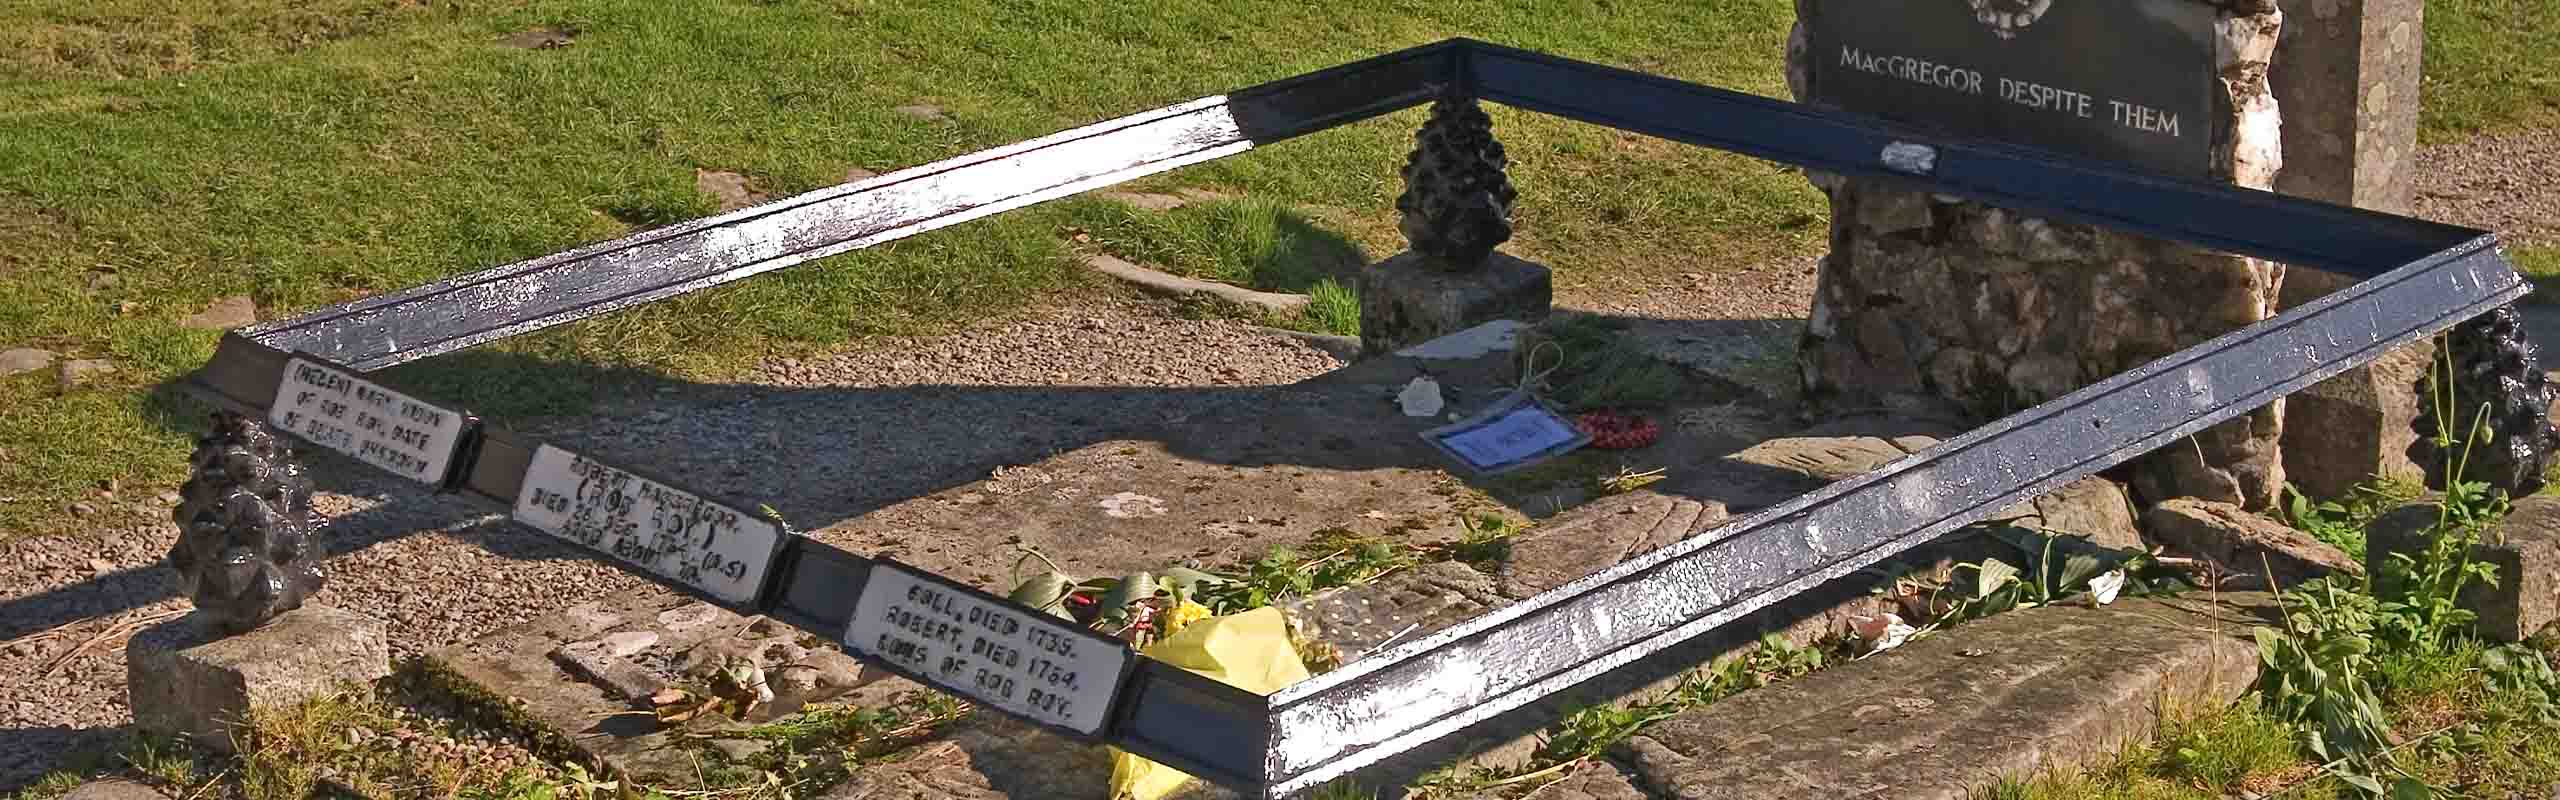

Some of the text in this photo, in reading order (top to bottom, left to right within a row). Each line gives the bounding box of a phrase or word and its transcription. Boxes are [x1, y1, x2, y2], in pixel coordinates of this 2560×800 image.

[2000, 77, 2094, 118] DESPITE
[2109, 100, 2180, 137] THEM
[969, 606, 1018, 635] DIED
[972, 637, 1018, 668] DIED
[940, 656, 968, 676] OF
[975, 668, 1015, 699] ROB
